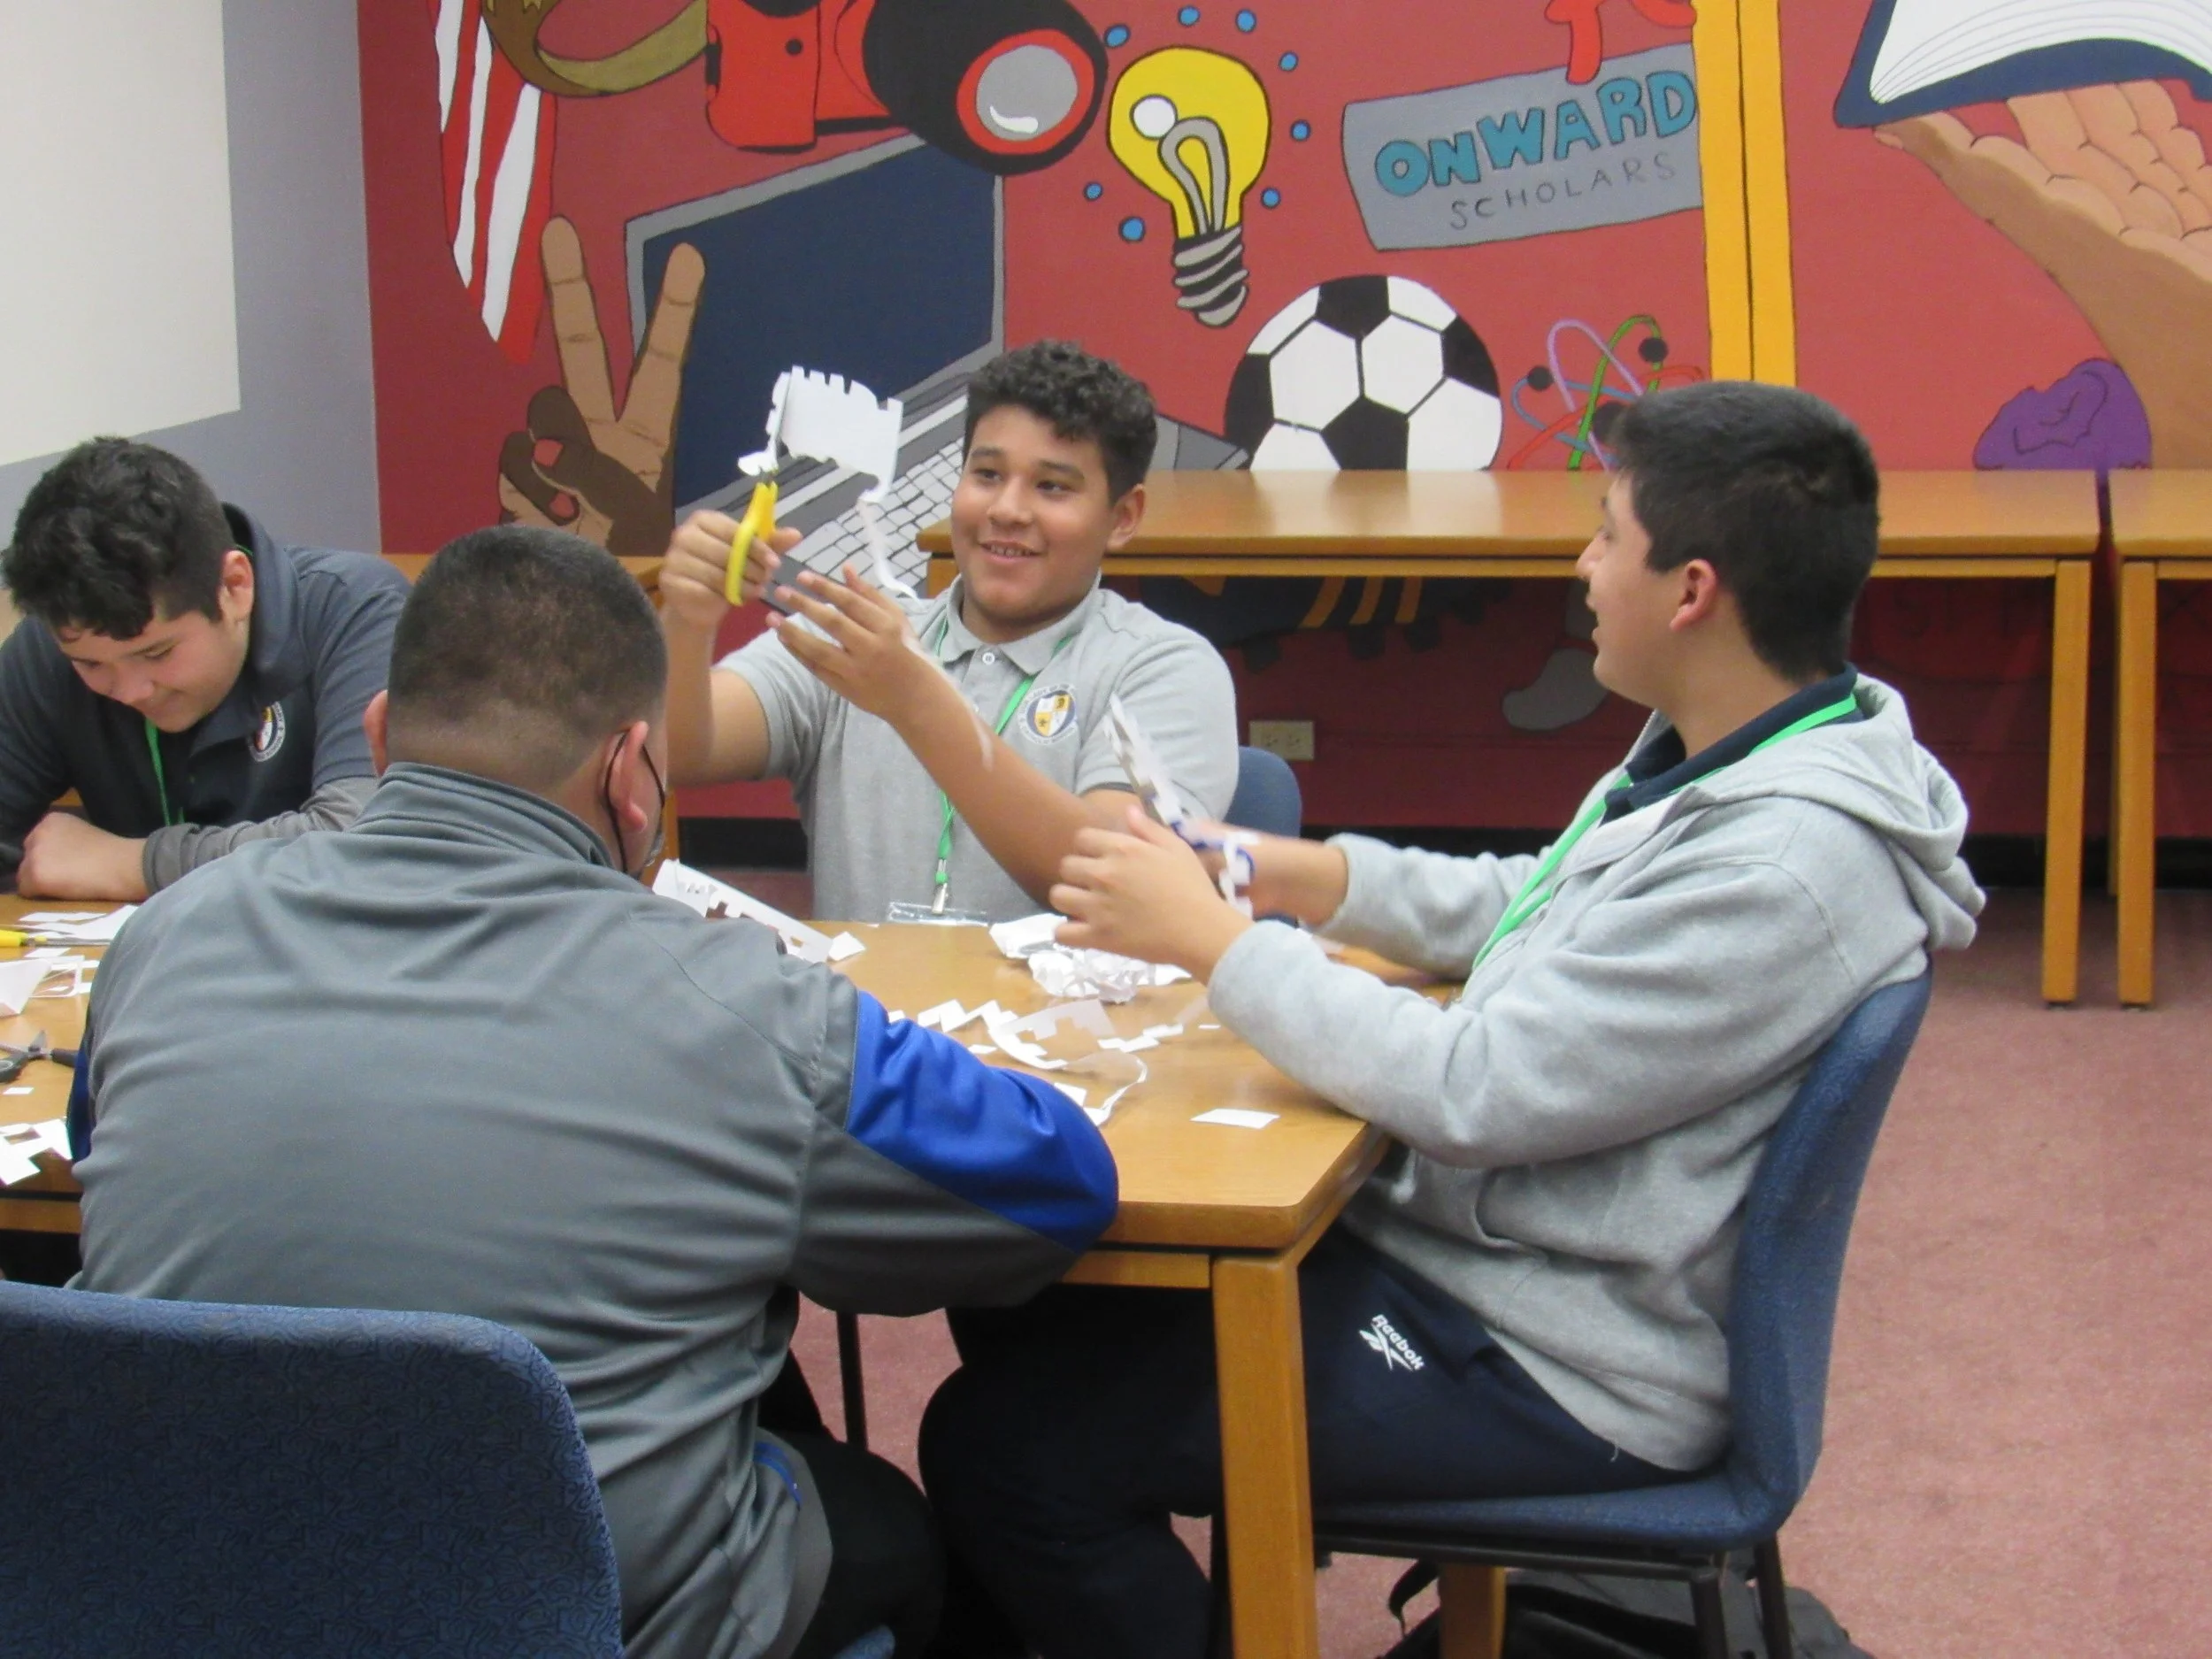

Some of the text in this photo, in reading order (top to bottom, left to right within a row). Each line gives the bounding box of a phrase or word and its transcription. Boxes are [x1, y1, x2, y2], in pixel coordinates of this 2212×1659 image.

[1375, 70, 1696, 196] ONWARD
[1450, 152, 1676, 230] SCHOLARS
[1371, 1314, 1425, 1371] Reebok
